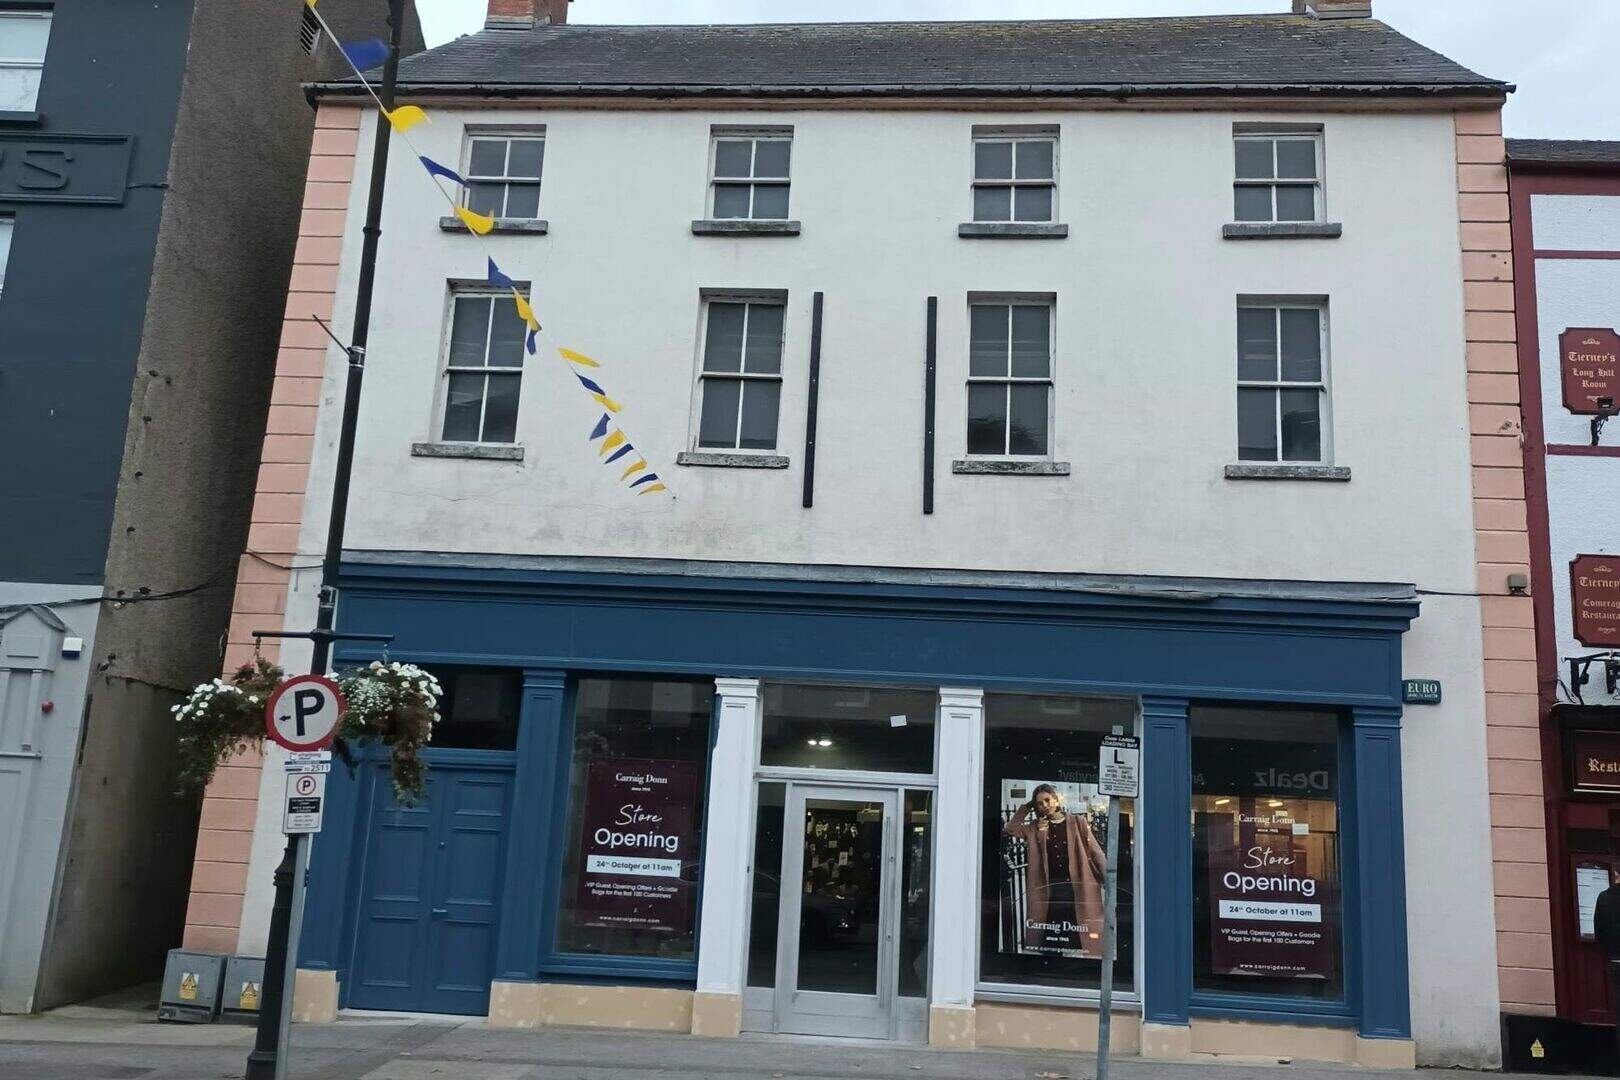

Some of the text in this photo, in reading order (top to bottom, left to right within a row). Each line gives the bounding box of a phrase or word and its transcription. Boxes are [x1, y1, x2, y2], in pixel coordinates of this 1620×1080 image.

[1568, 351, 1616, 362] Tierney's
[1572, 367, 1615, 378] Long Hill
[1582, 379, 1607, 388] Room
[1407, 682, 1438, 694] EURO
[295, 688, 325, 736] P
[1114, 749, 1125, 764] L
[615, 772, 668, 785] Carraig Donn
[302, 780, 311, 792] P
[615, 804, 663, 825] Store
[1238, 813, 1295, 826] Carraig Donn
[594, 828, 679, 853] Opening
[1243, 846, 1296, 869] Store
[611, 861, 641, 869] October
[652, 863, 673, 871] 11am
[612, 883, 636, 891] Opening
[1223, 871, 1315, 897] Opening
[591, 888, 605, 896] Bags
[643, 891, 672, 899] Customers
[1245, 907, 1278, 915] October
[1290, 908, 1313, 916] 11am
[1026, 918, 1089, 934] Carraig Donn
[1228, 935, 1243, 943] Bags
[1249, 930, 1275, 938] Opening
